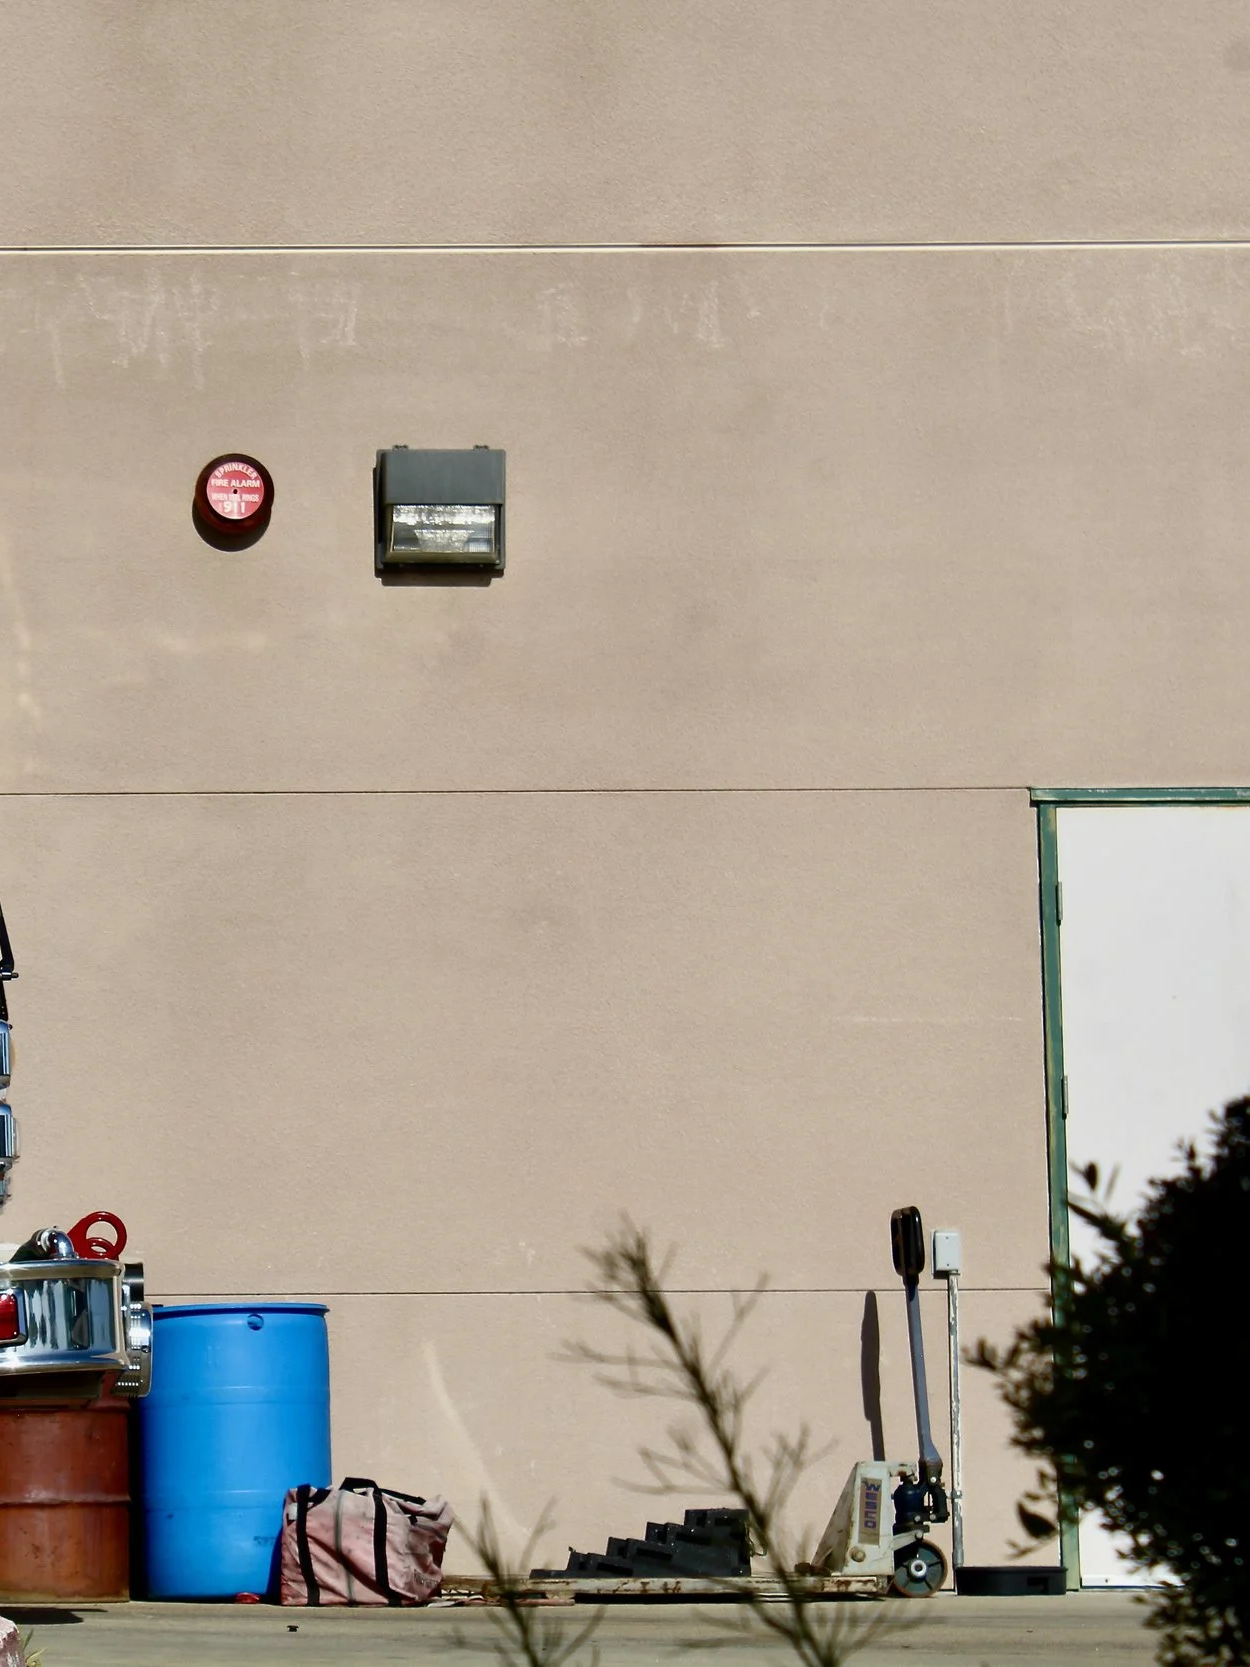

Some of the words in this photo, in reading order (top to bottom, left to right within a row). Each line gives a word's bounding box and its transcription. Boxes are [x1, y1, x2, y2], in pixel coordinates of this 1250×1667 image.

[214, 463, 258, 480] SPRINKLER
[211, 479, 229, 487] FIRE
[230, 479, 260, 488] ALARM
